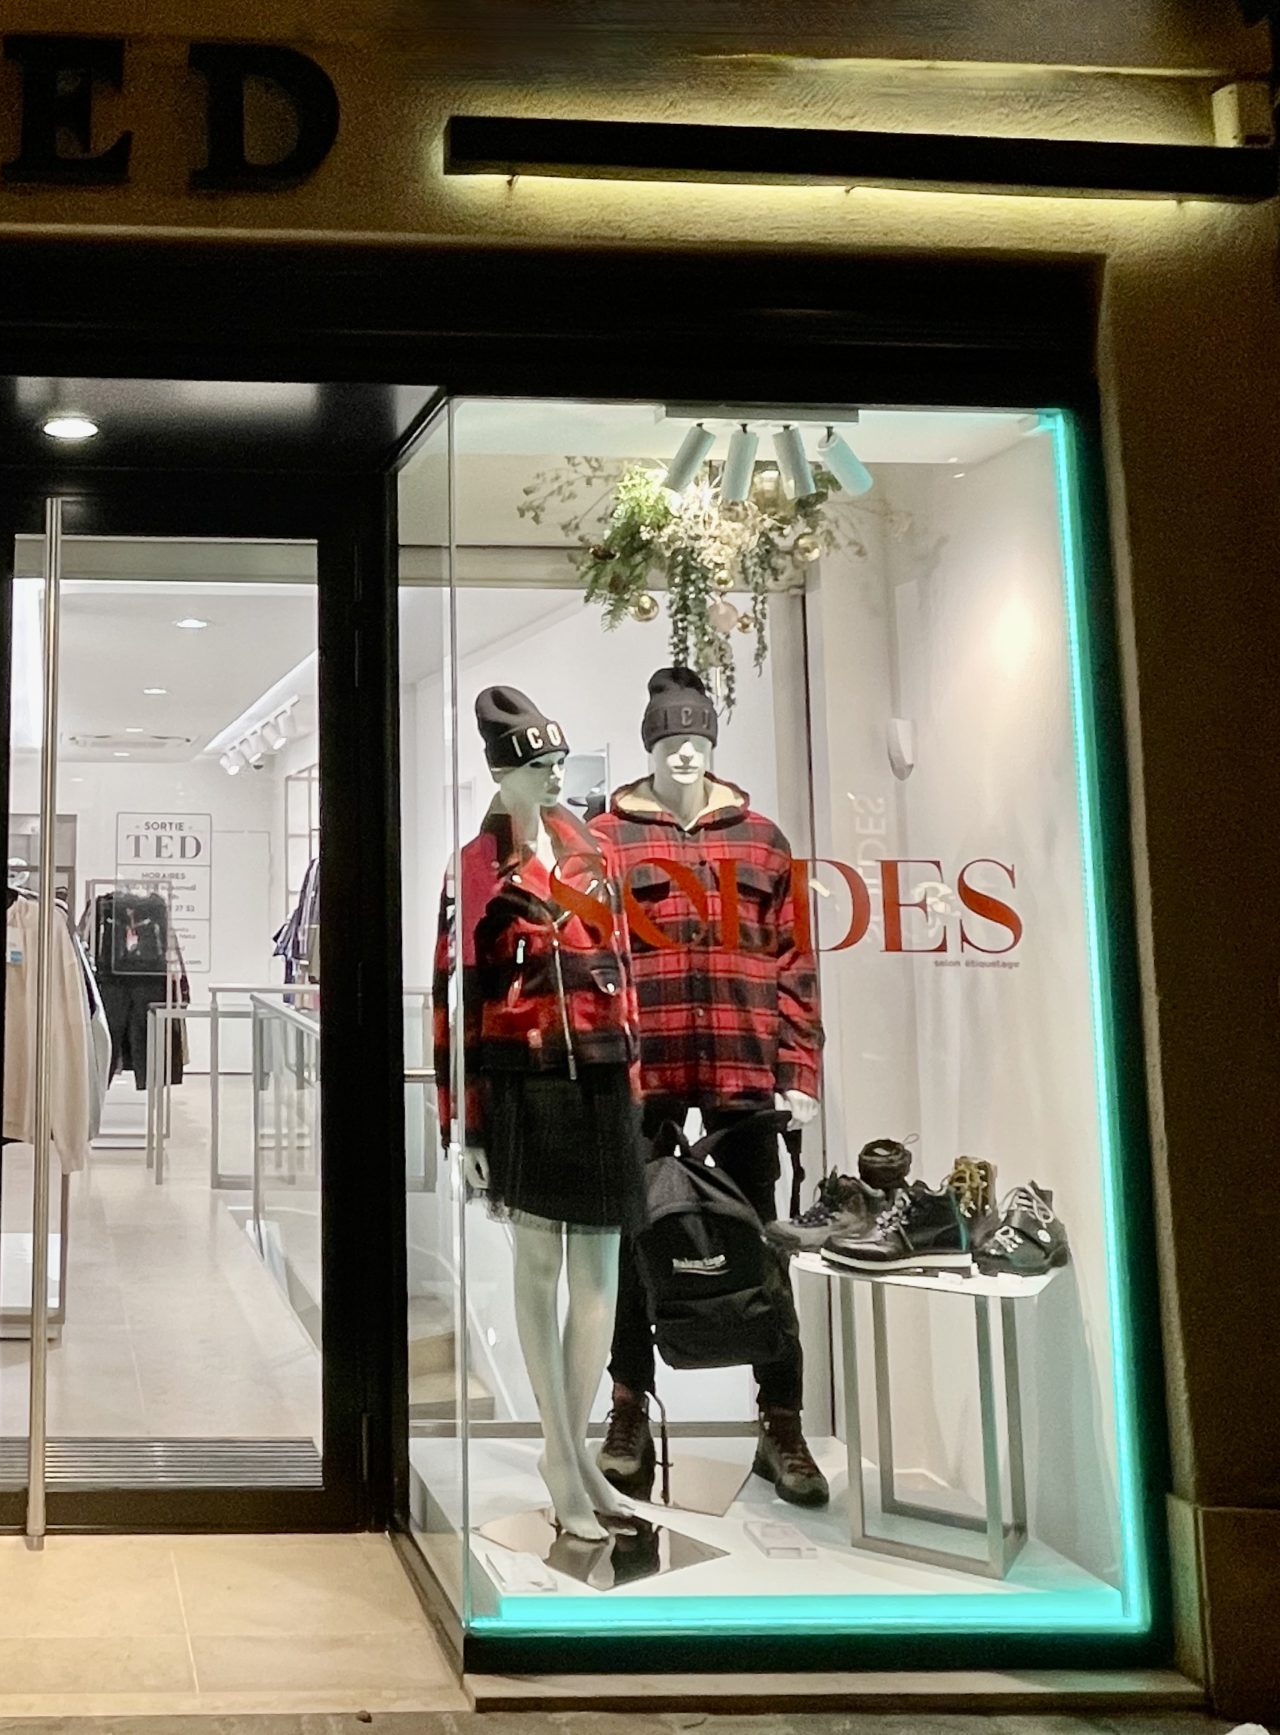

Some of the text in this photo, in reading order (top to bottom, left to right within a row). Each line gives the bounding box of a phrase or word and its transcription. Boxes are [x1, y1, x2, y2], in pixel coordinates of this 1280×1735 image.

[144, 821, 185, 831] SORTIE
[126, 834, 202, 859] TED
[549, 857, 1023, 954] SOLDES
